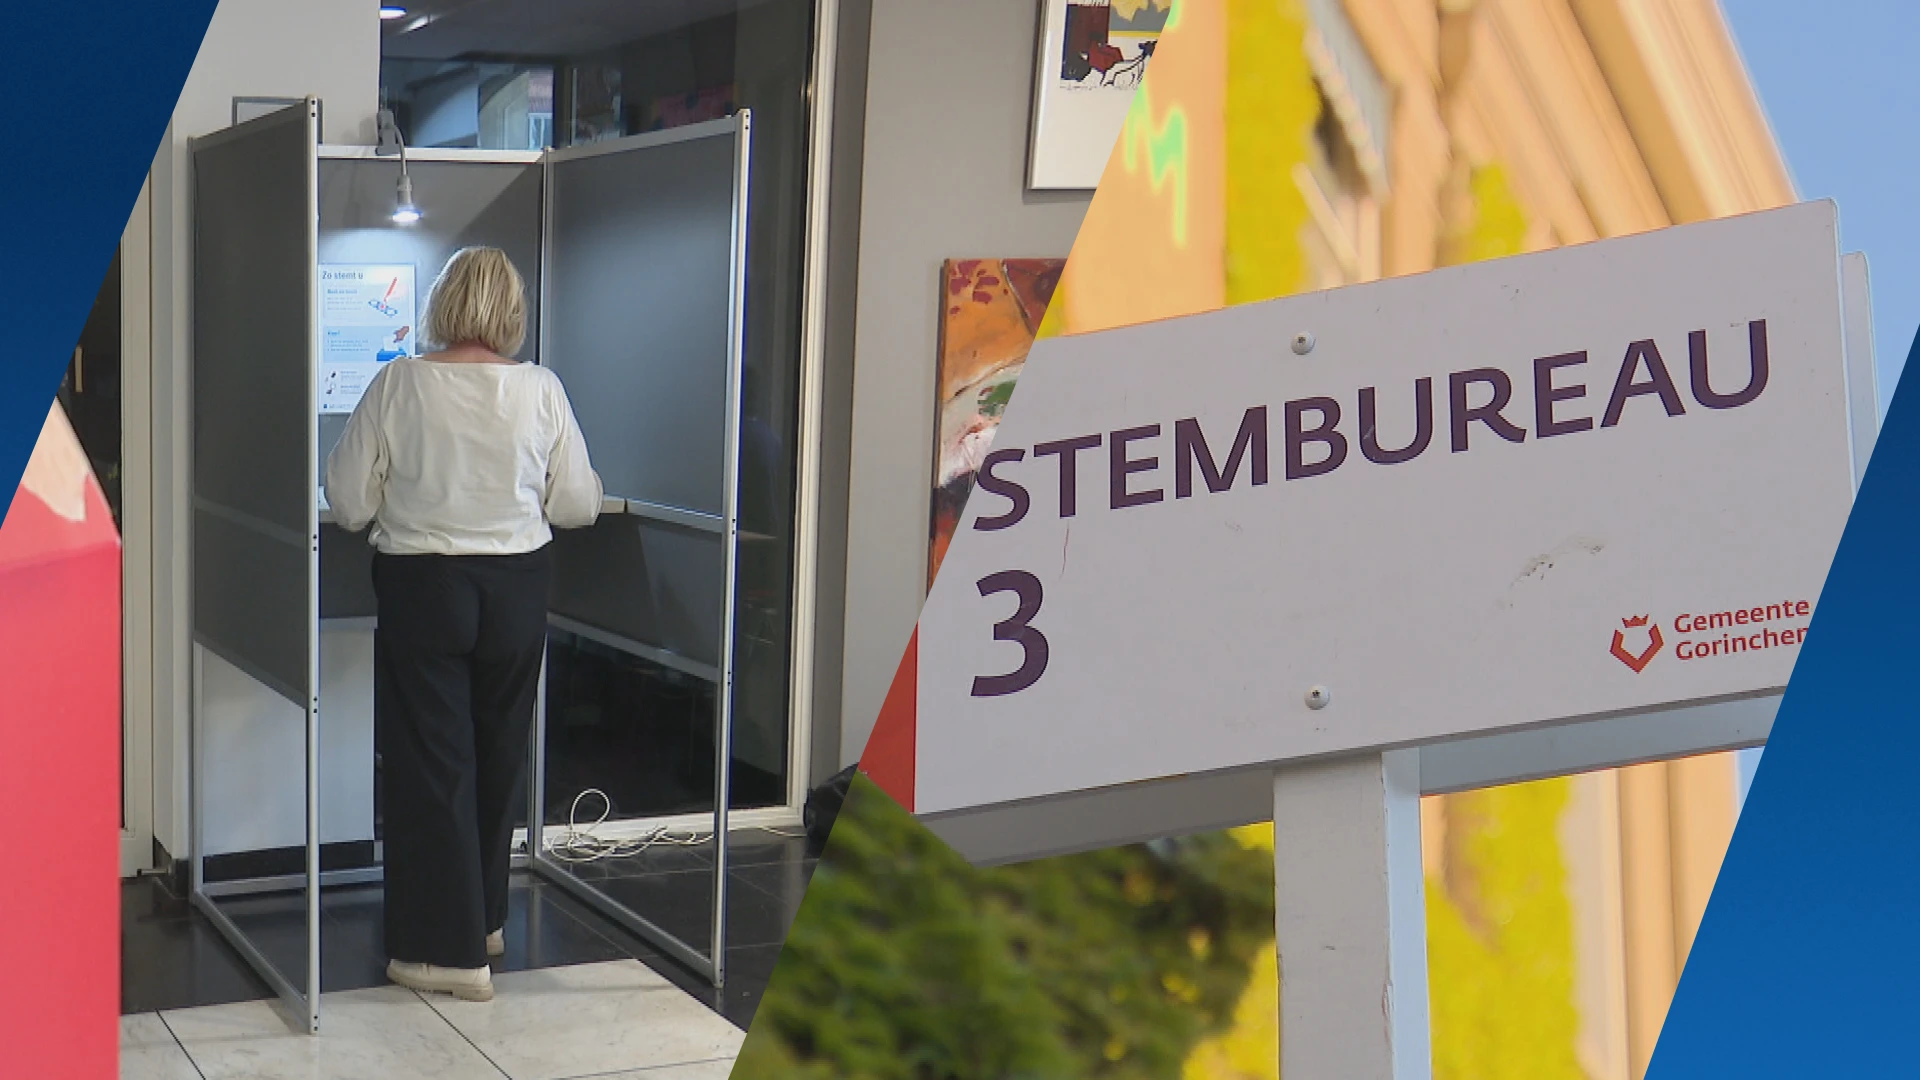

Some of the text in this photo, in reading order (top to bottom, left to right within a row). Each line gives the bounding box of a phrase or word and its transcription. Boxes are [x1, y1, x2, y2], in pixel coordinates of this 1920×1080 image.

[322, 270, 364, 280] Zo stemt u
[973, 319, 1770, 532] STEMBUREAU
[971, 570, 1050, 697] 3
[1674, 600, 1810, 633] Gemeente
